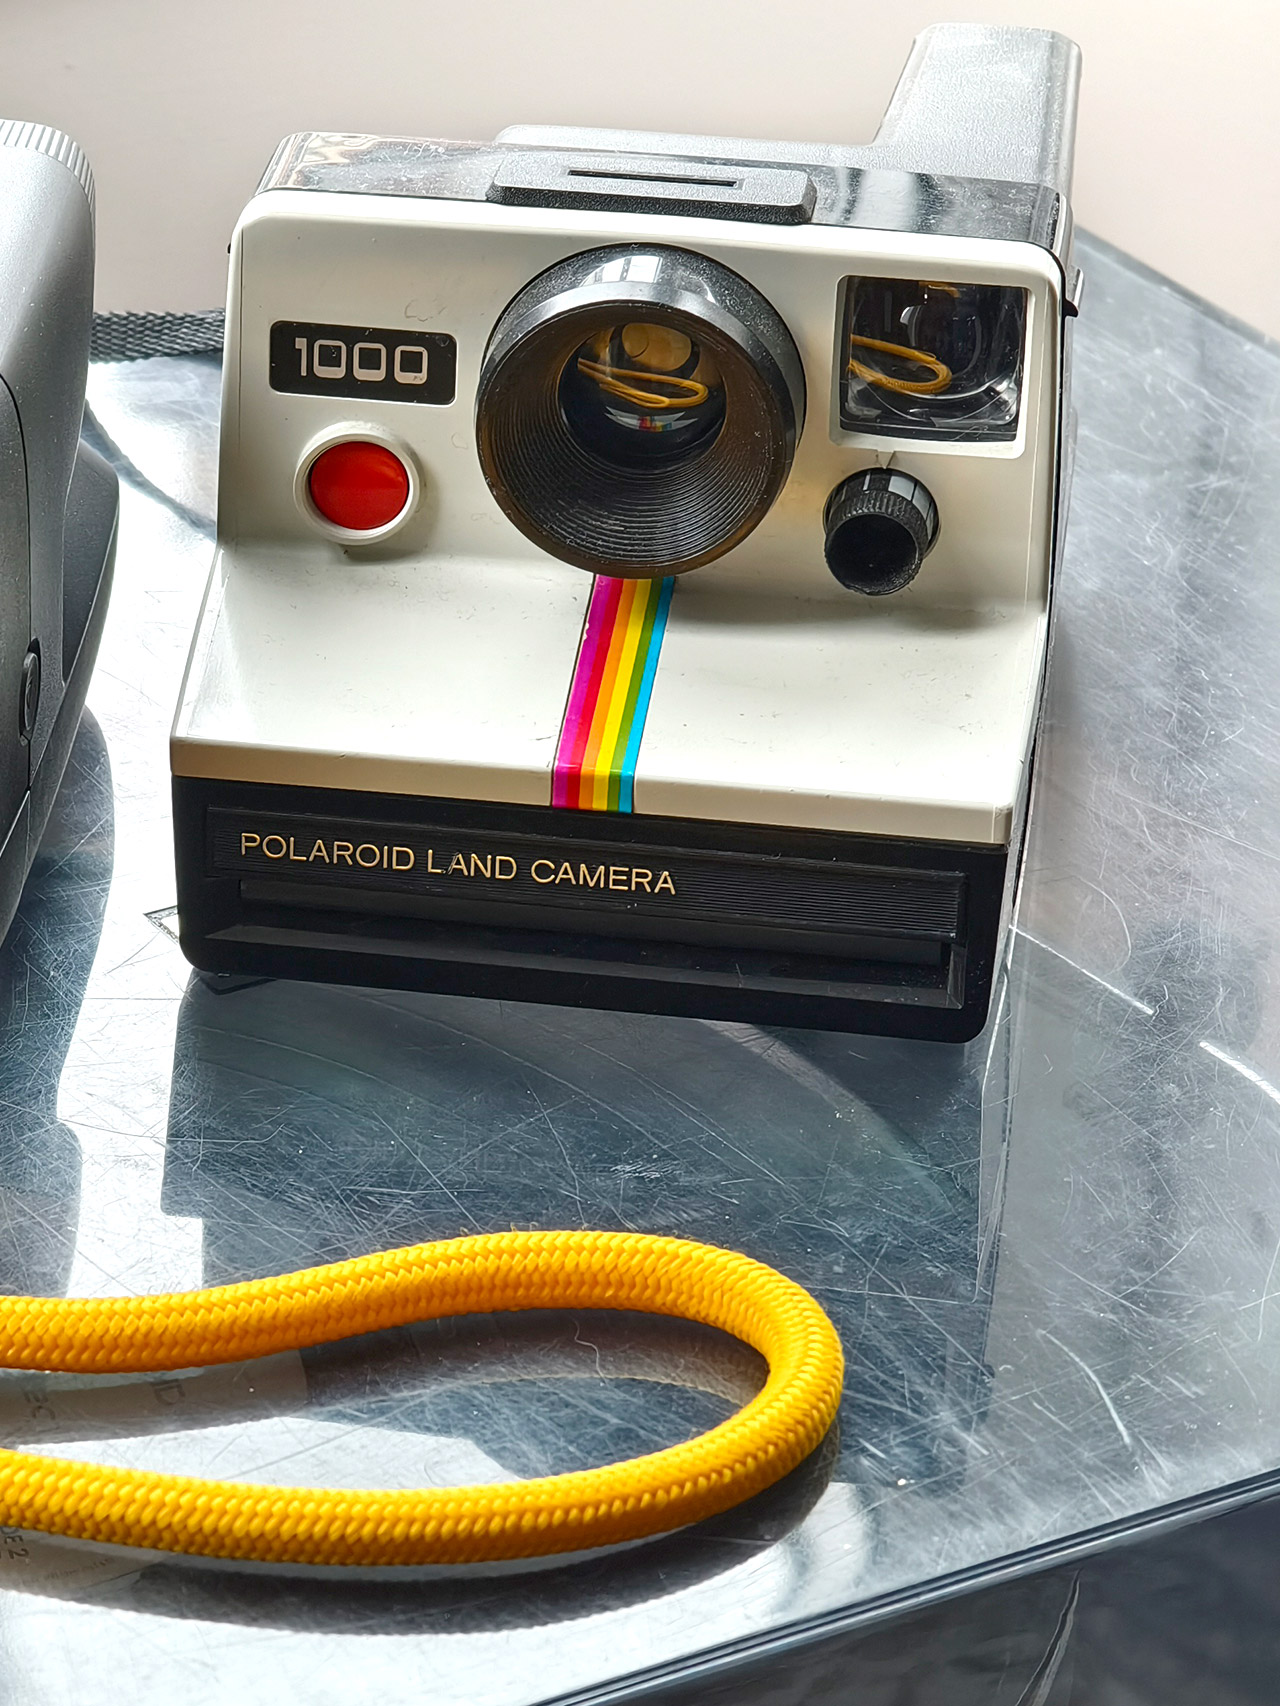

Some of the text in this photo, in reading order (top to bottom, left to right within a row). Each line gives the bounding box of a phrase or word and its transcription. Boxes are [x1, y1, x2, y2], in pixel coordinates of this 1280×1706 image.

[294, 336, 429, 385] 1000
[240, 832, 677, 896] POLAROID LAND CAMERA
